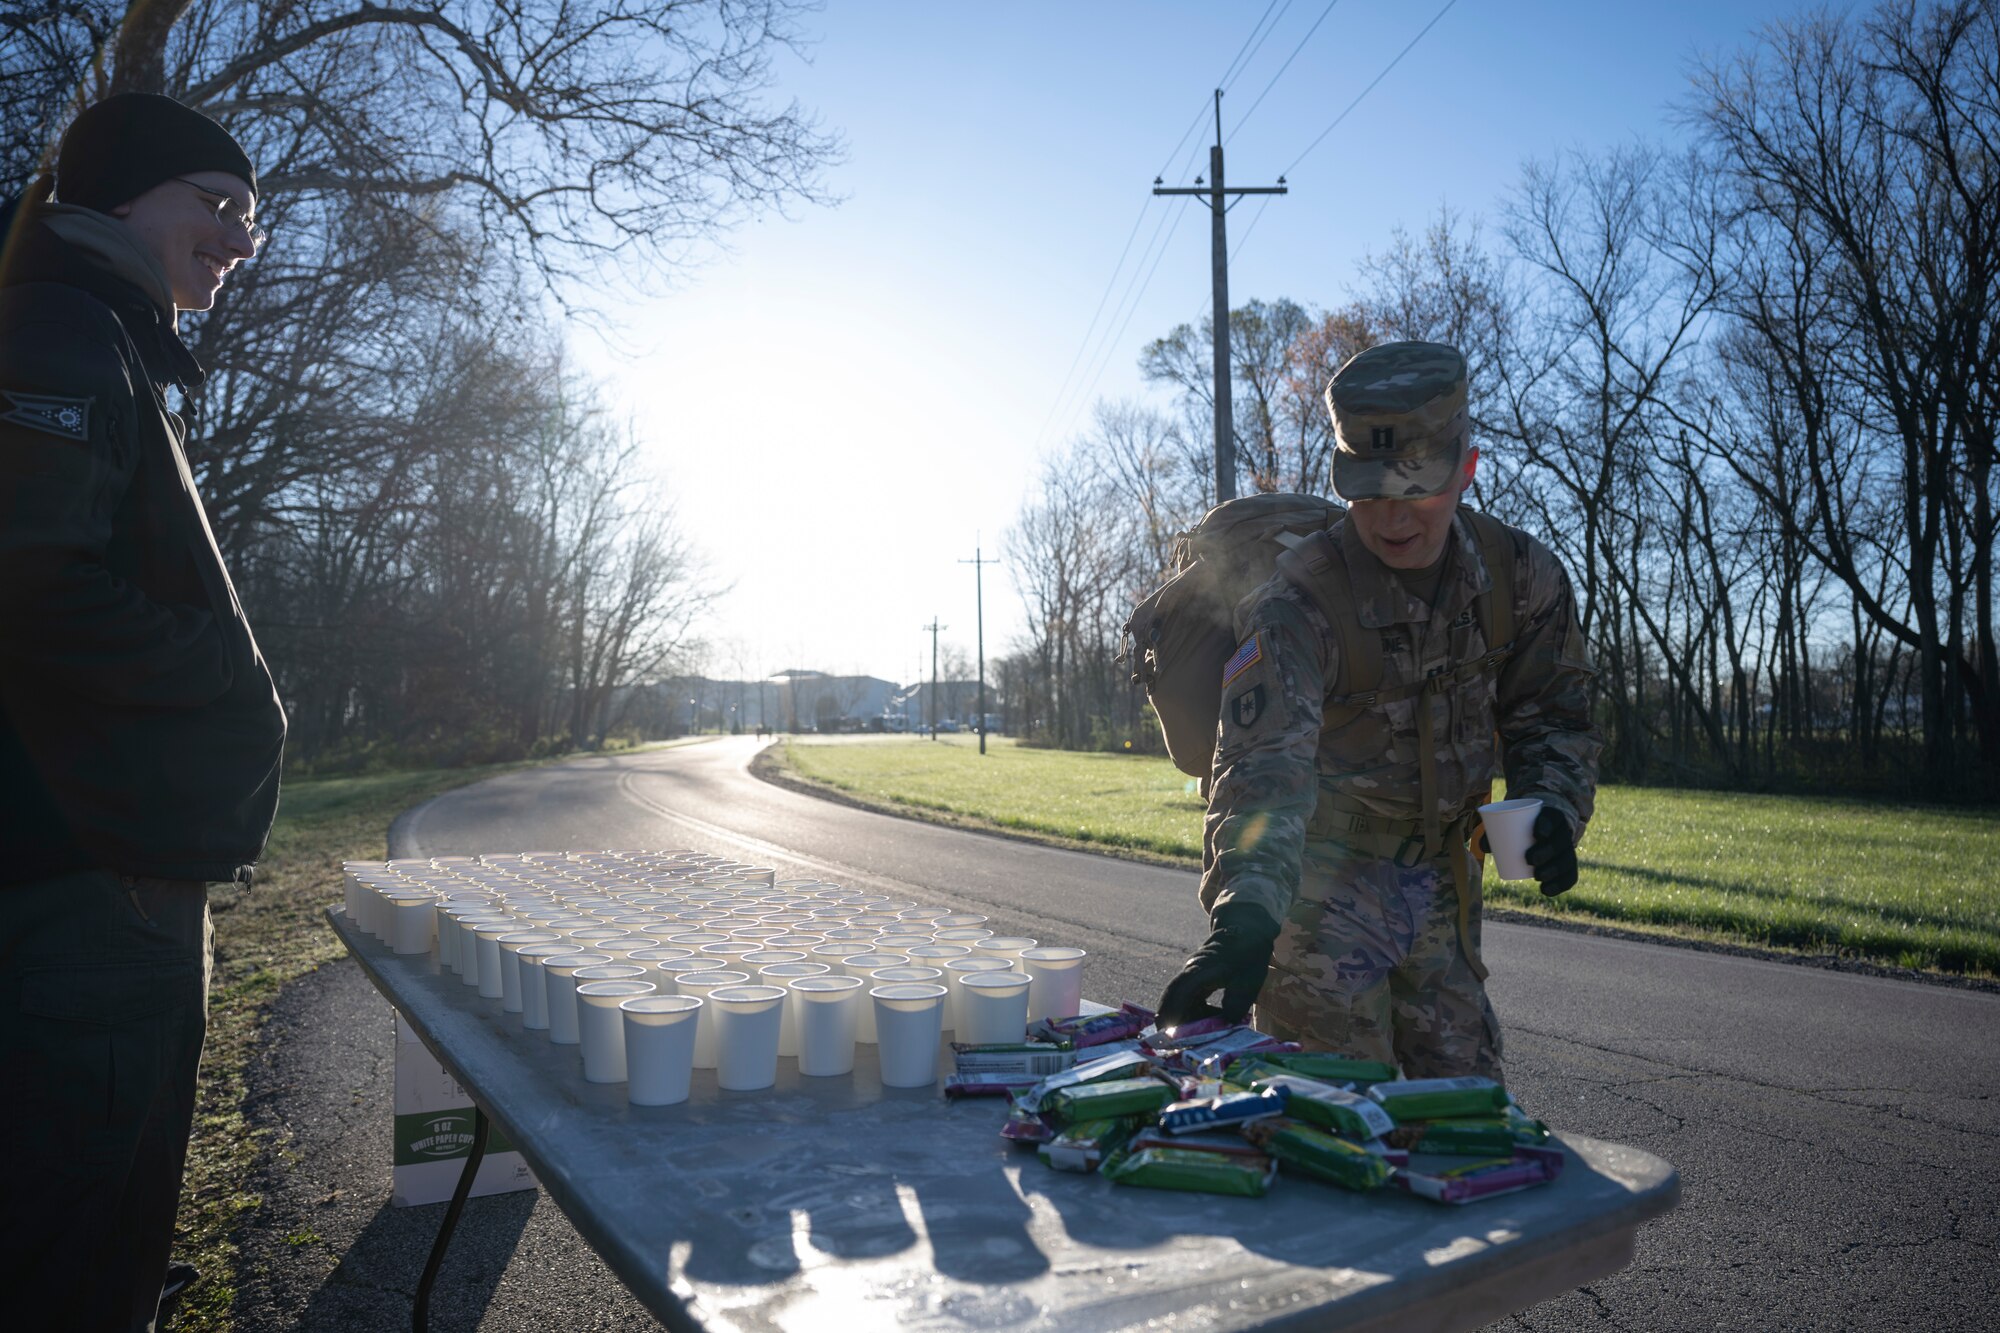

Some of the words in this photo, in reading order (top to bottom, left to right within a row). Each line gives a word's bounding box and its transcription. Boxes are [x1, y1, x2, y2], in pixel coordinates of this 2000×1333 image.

[433, 1123, 440, 1132] 8
[441, 1121, 452, 1131] OZ
[410, 1136, 435, 1152] WHITE
[435, 1133, 457, 1144] PAPER
